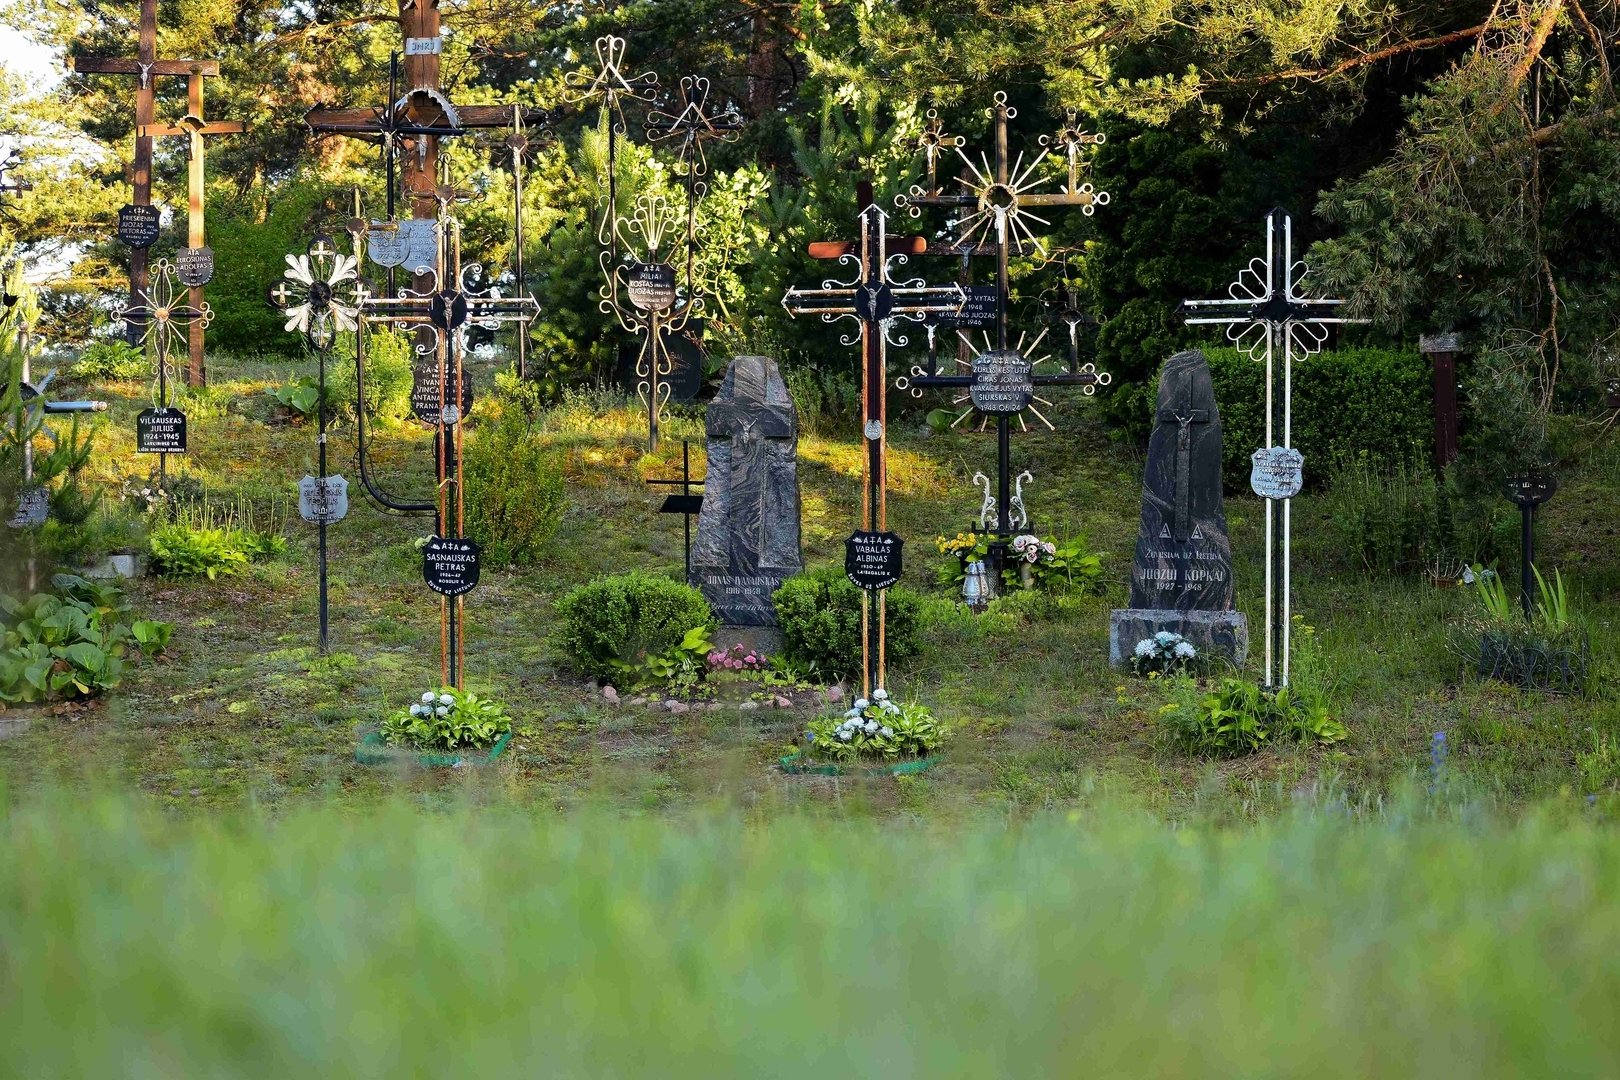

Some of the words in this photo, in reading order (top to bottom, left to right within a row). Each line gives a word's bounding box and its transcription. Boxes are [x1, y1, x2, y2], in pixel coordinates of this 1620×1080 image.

[628, 280, 653, 288] KOSTAS
[140, 417, 182, 425] VILKAUSKAS
[855, 545, 891, 554] VABALAS
[426, 553, 476, 563] SASNAUSKAS
[856, 554, 888, 563] ALBINAS
[435, 562, 466, 572] PETRAS
[1139, 568, 1177, 581] JUOZUI
[1184, 569, 1223, 582] KOPKAI
[707, 575, 731, 585] JONAS
